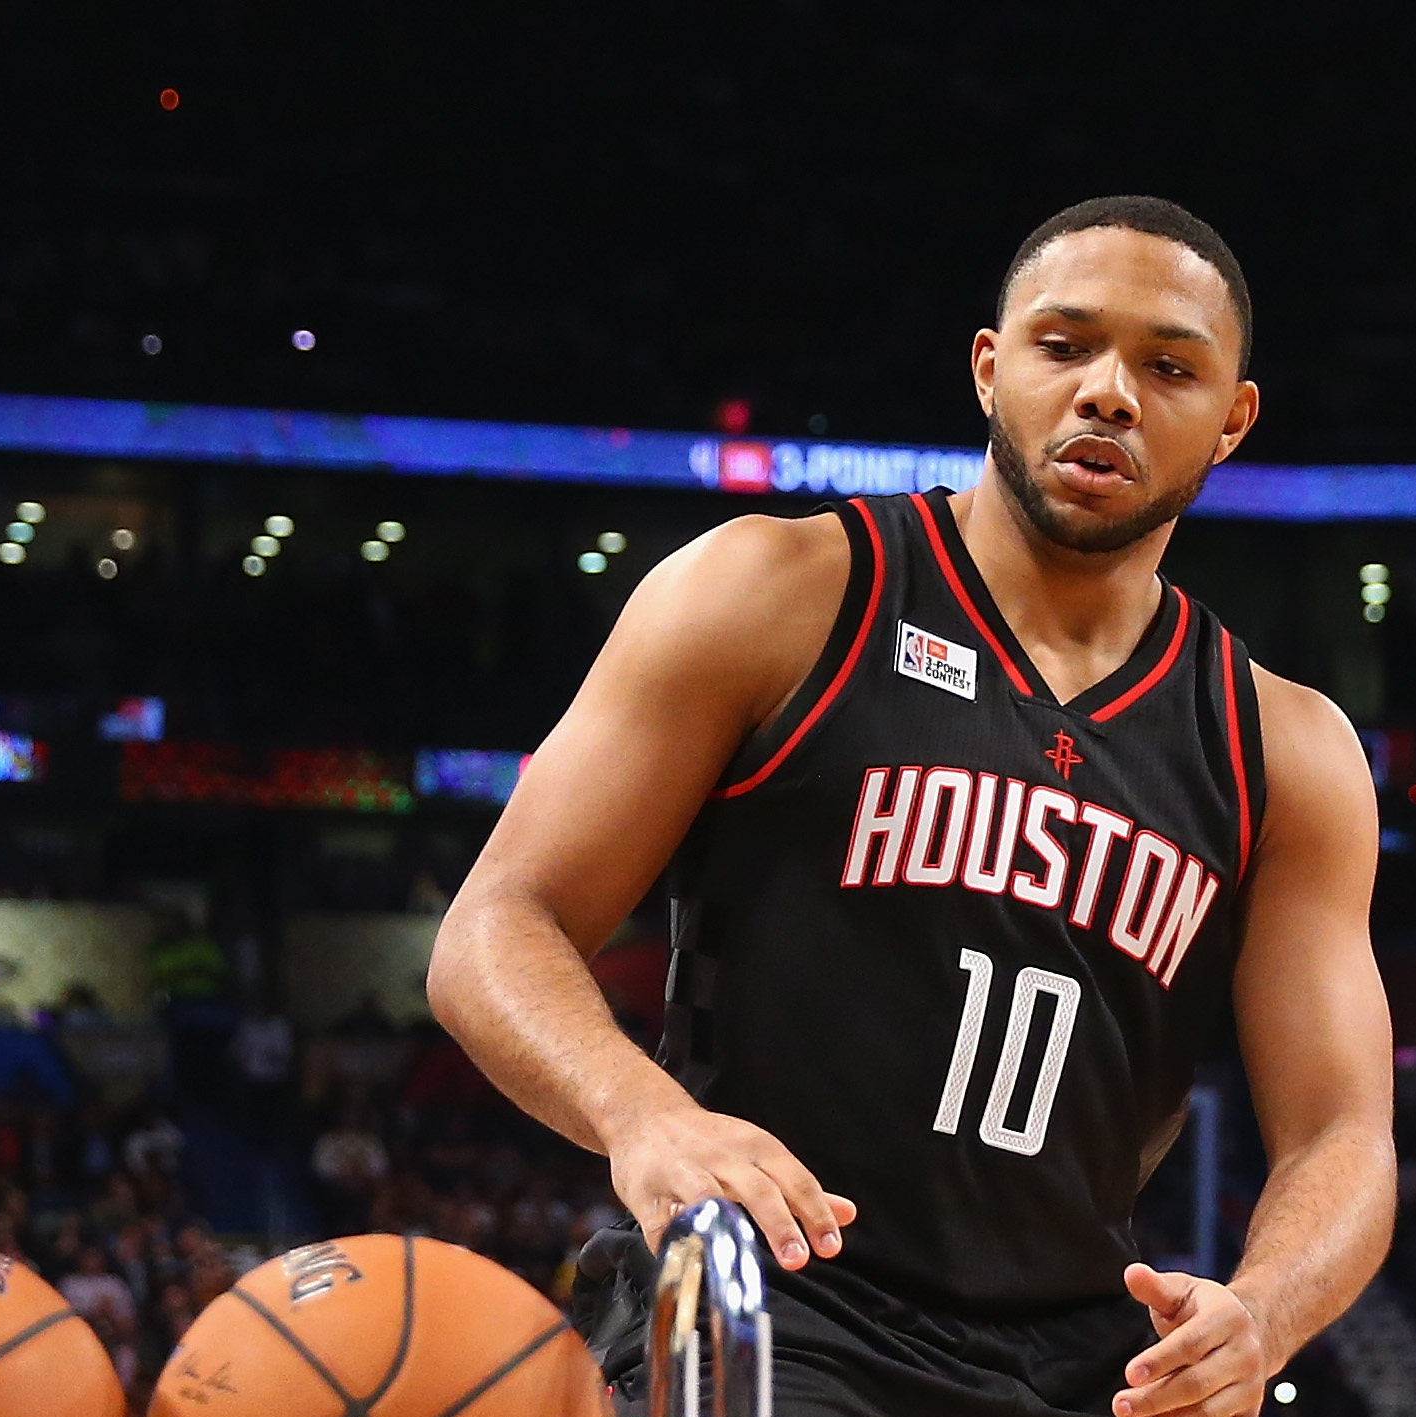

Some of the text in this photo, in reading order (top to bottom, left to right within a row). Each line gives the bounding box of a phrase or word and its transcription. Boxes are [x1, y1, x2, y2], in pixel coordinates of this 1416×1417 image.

[925, 656, 966, 680] 3-POINT
[925, 667, 971, 691] CONTEST
[840, 766, 1220, 991] HOUSTON
[933, 947, 1082, 1157] 10
